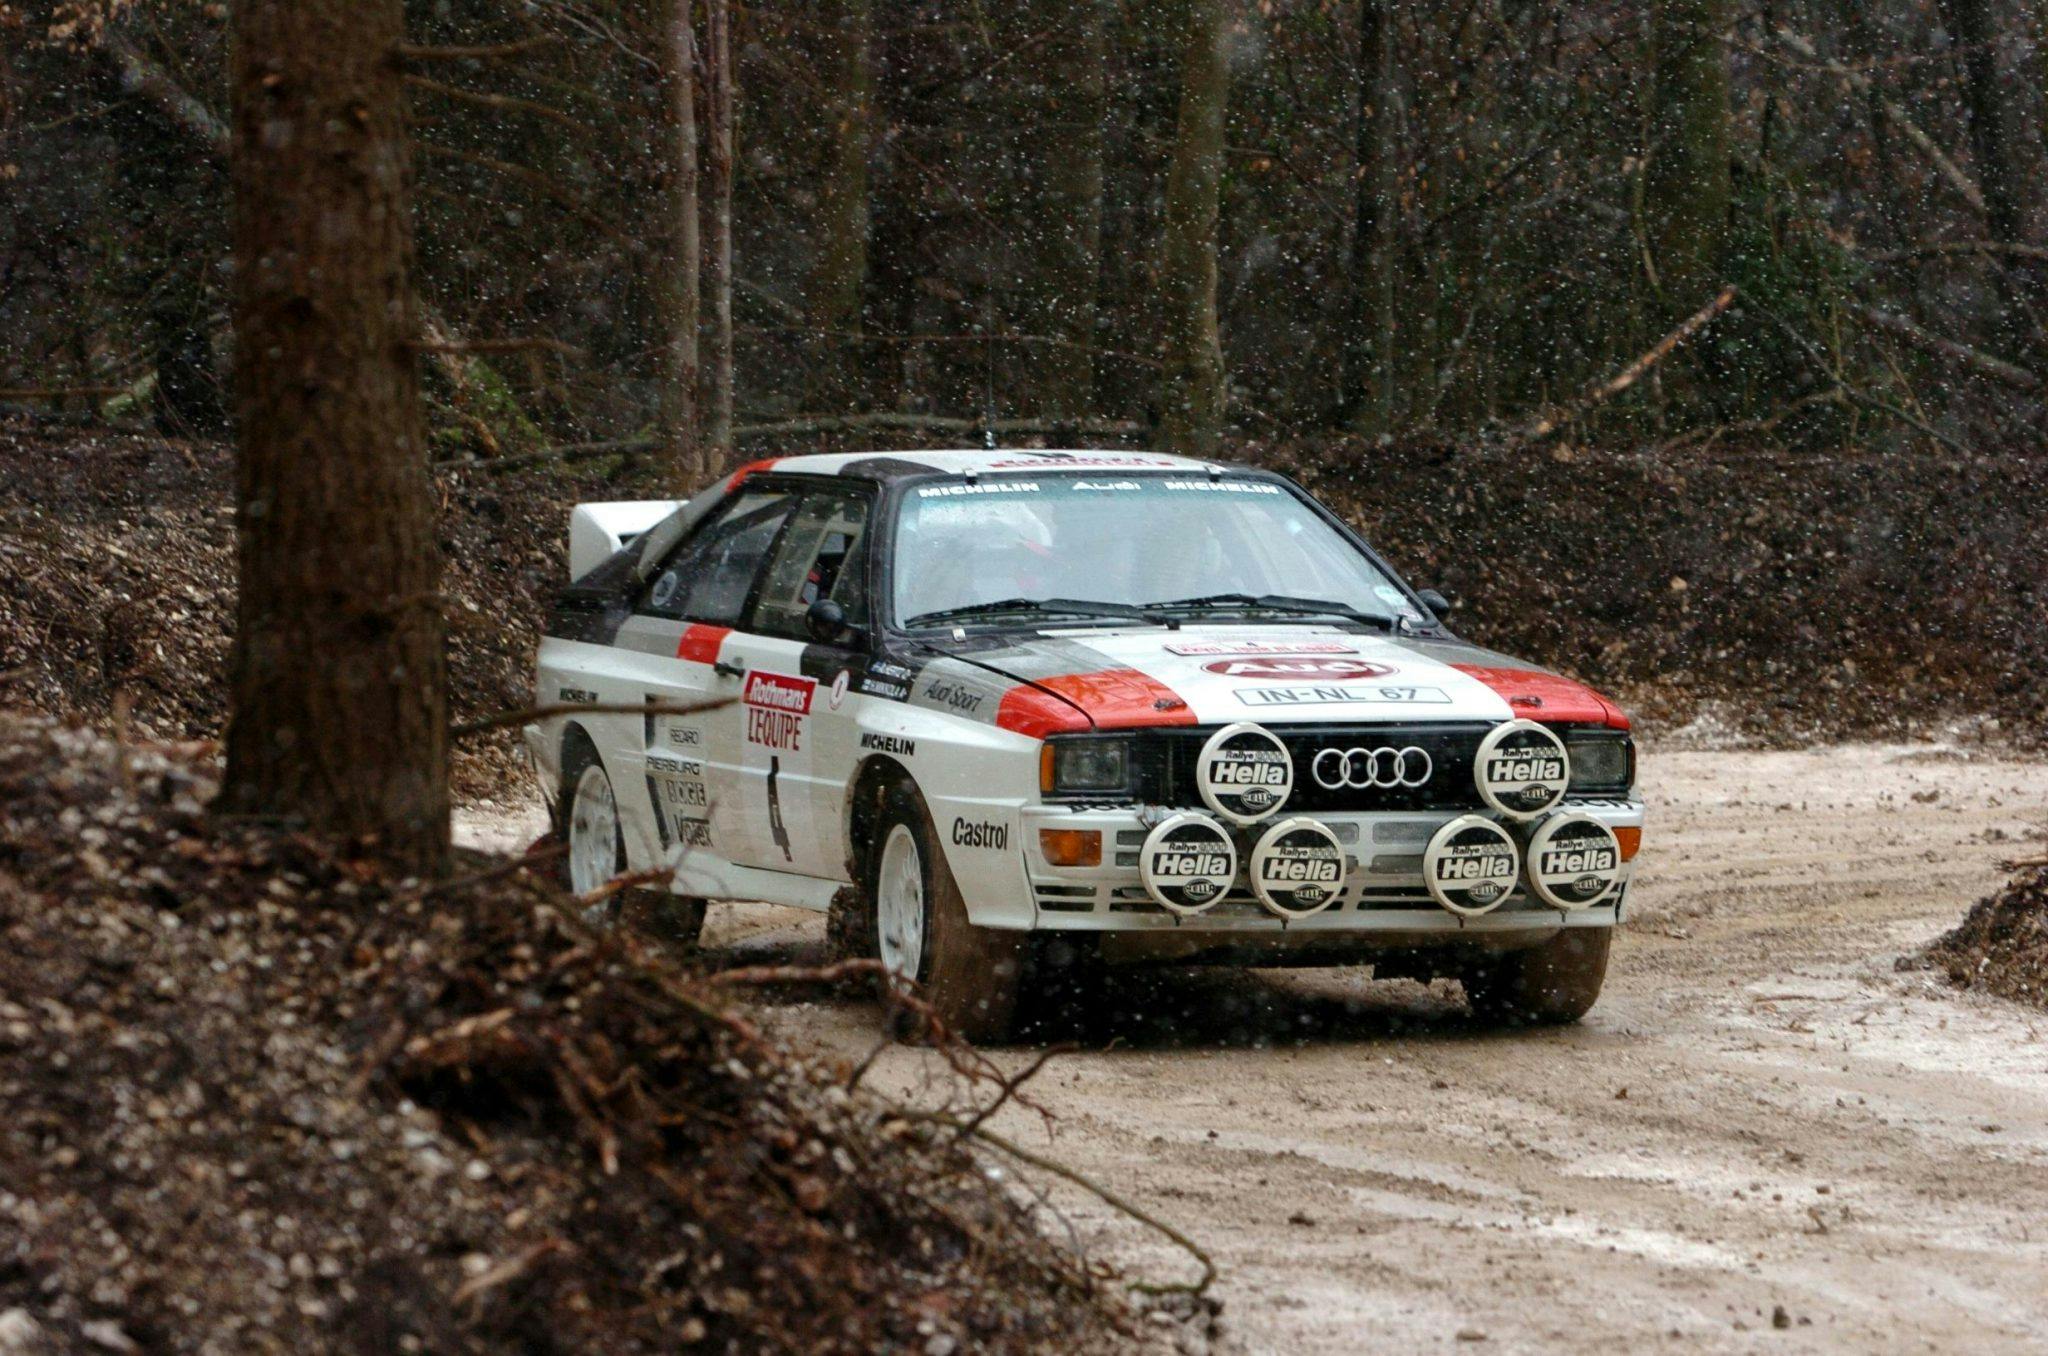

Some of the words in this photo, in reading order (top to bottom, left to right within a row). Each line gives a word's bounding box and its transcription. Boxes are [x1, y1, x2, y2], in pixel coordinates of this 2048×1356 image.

[918, 482, 1040, 498] MICHELIN
[1164, 481, 1279, 494] MICHELIN
[751, 676, 808, 711] Rothmans
[949, 683, 984, 712] Sport
[1256, 687, 1366, 702] IN-NL
[1379, 687, 1418, 700] 67
[860, 731, 915, 756] MICHELIN
[1502, 748, 1531, 759] Rallye
[646, 756, 700, 775] PIERBURG
[1225, 751, 1254, 763] Rallye
[1214, 762, 1285, 784] Hella
[1492, 760, 1562, 782] Hella
[952, 816, 1009, 850] Castrol
[1168, 843, 1198, 855] Rallye
[1279, 847, 1308, 859] Rallye
[1451, 845, 1480, 857] Rallye
[1555, 840, 1583, 852] Rallye
[1157, 854, 1227, 875] Hella
[1268, 859, 1337, 881] Hella
[1442, 857, 1510, 879] Hella
[1546, 851, 1612, 873] Hella
